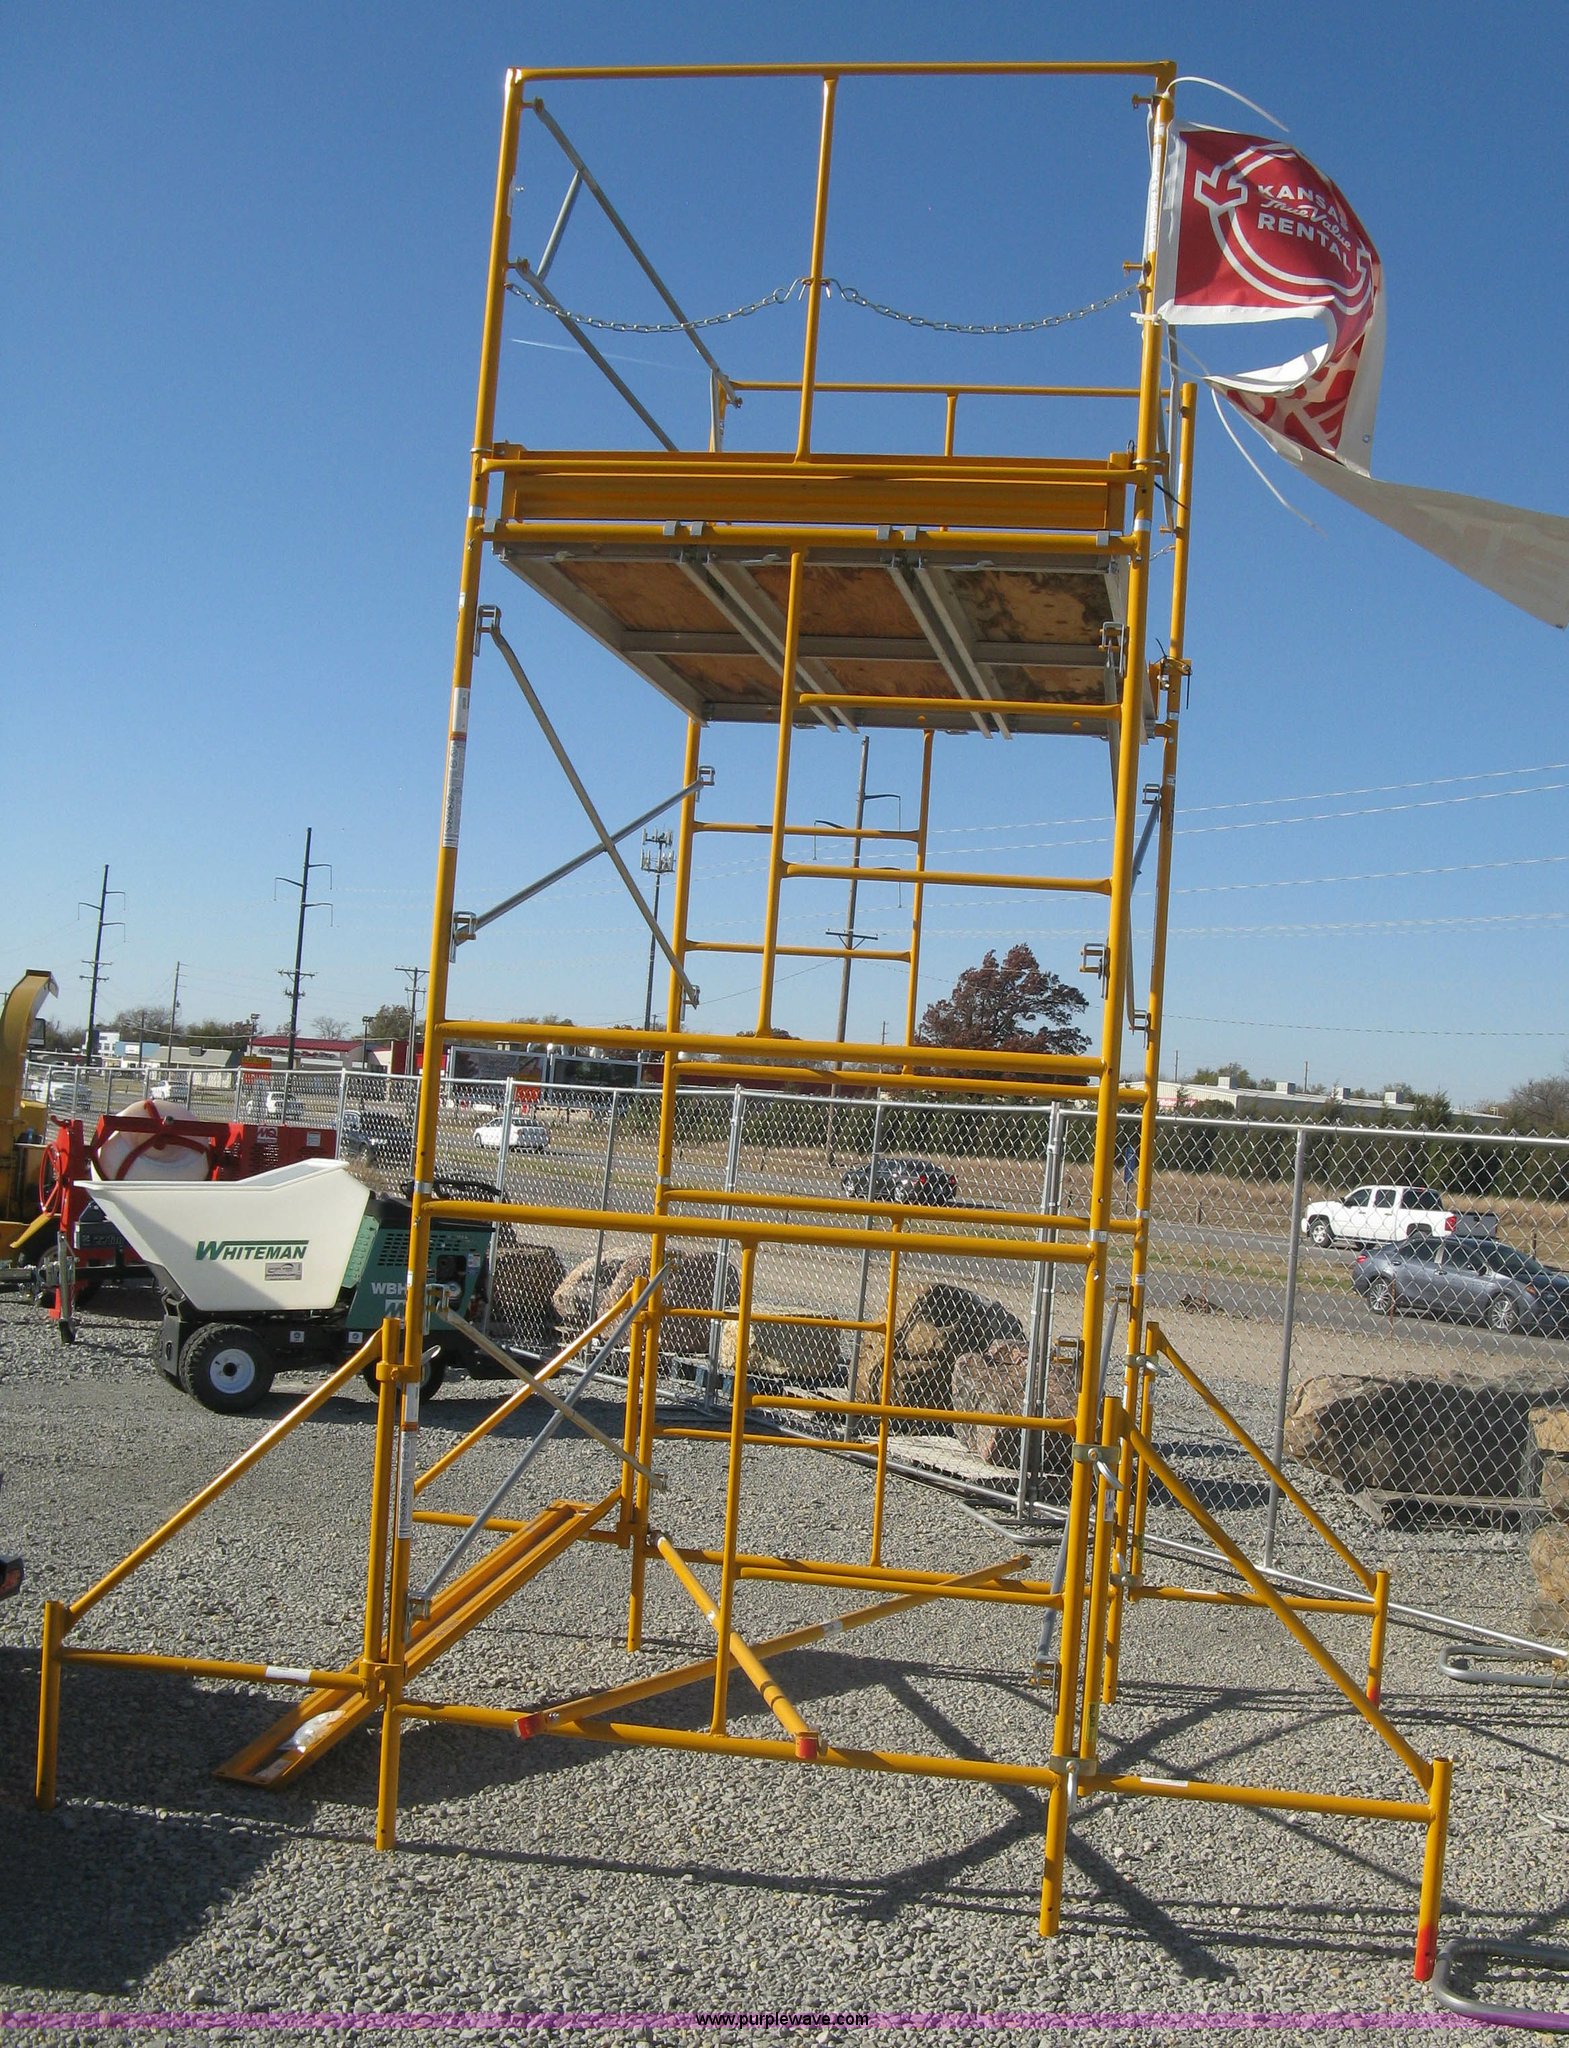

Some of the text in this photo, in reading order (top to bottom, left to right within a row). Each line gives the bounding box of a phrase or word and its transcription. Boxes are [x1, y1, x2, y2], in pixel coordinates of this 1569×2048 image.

[1257, 211, 1352, 273] RENTAL
[1298, 204, 1351, 252] Value
[195, 1240, 309, 1260] WHITEMAN
